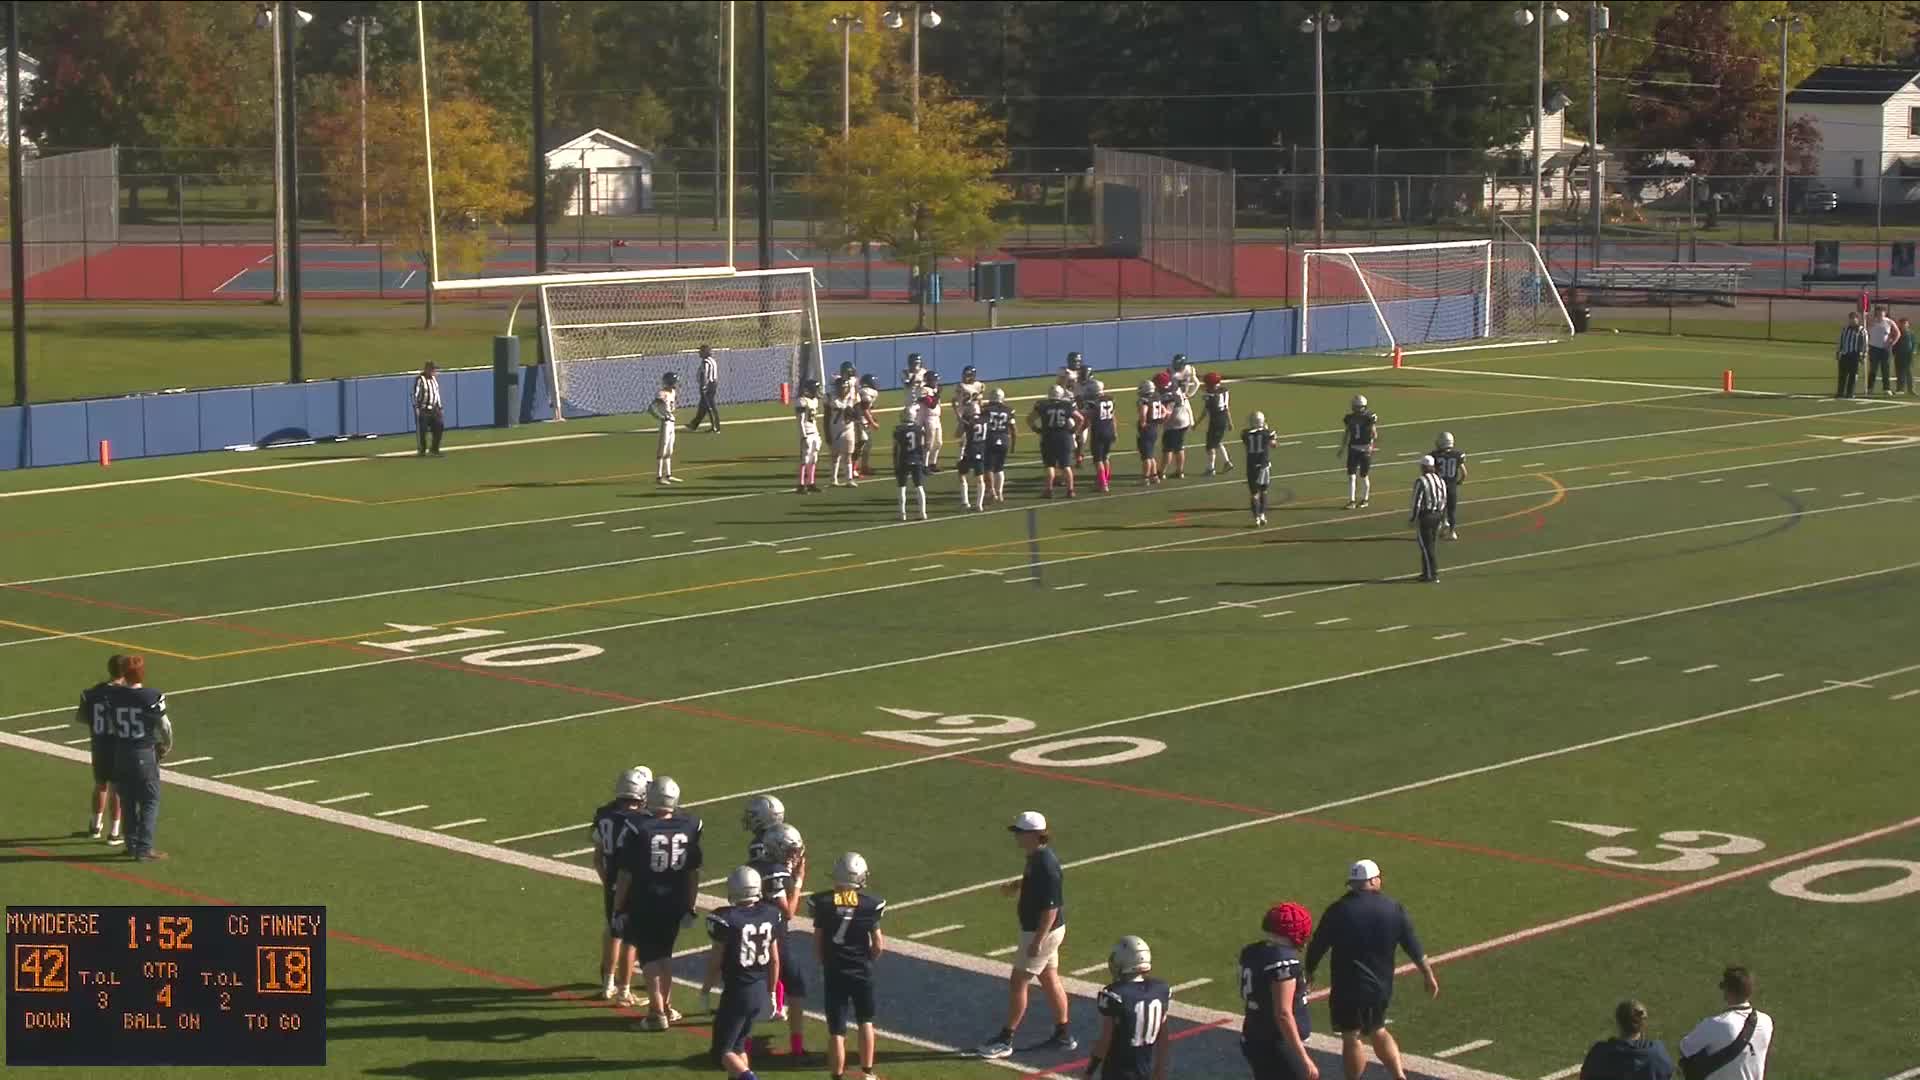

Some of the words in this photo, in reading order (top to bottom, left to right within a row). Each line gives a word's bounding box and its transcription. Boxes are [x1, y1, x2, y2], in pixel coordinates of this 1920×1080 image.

[989, 411, 1008, 431] 52
[116, 707, 145, 739] 55
[650, 833, 688, 873] 66
[740, 921, 773, 968] 63
[832, 907, 855, 945] 7
[1130, 998, 1161, 1047] 10
